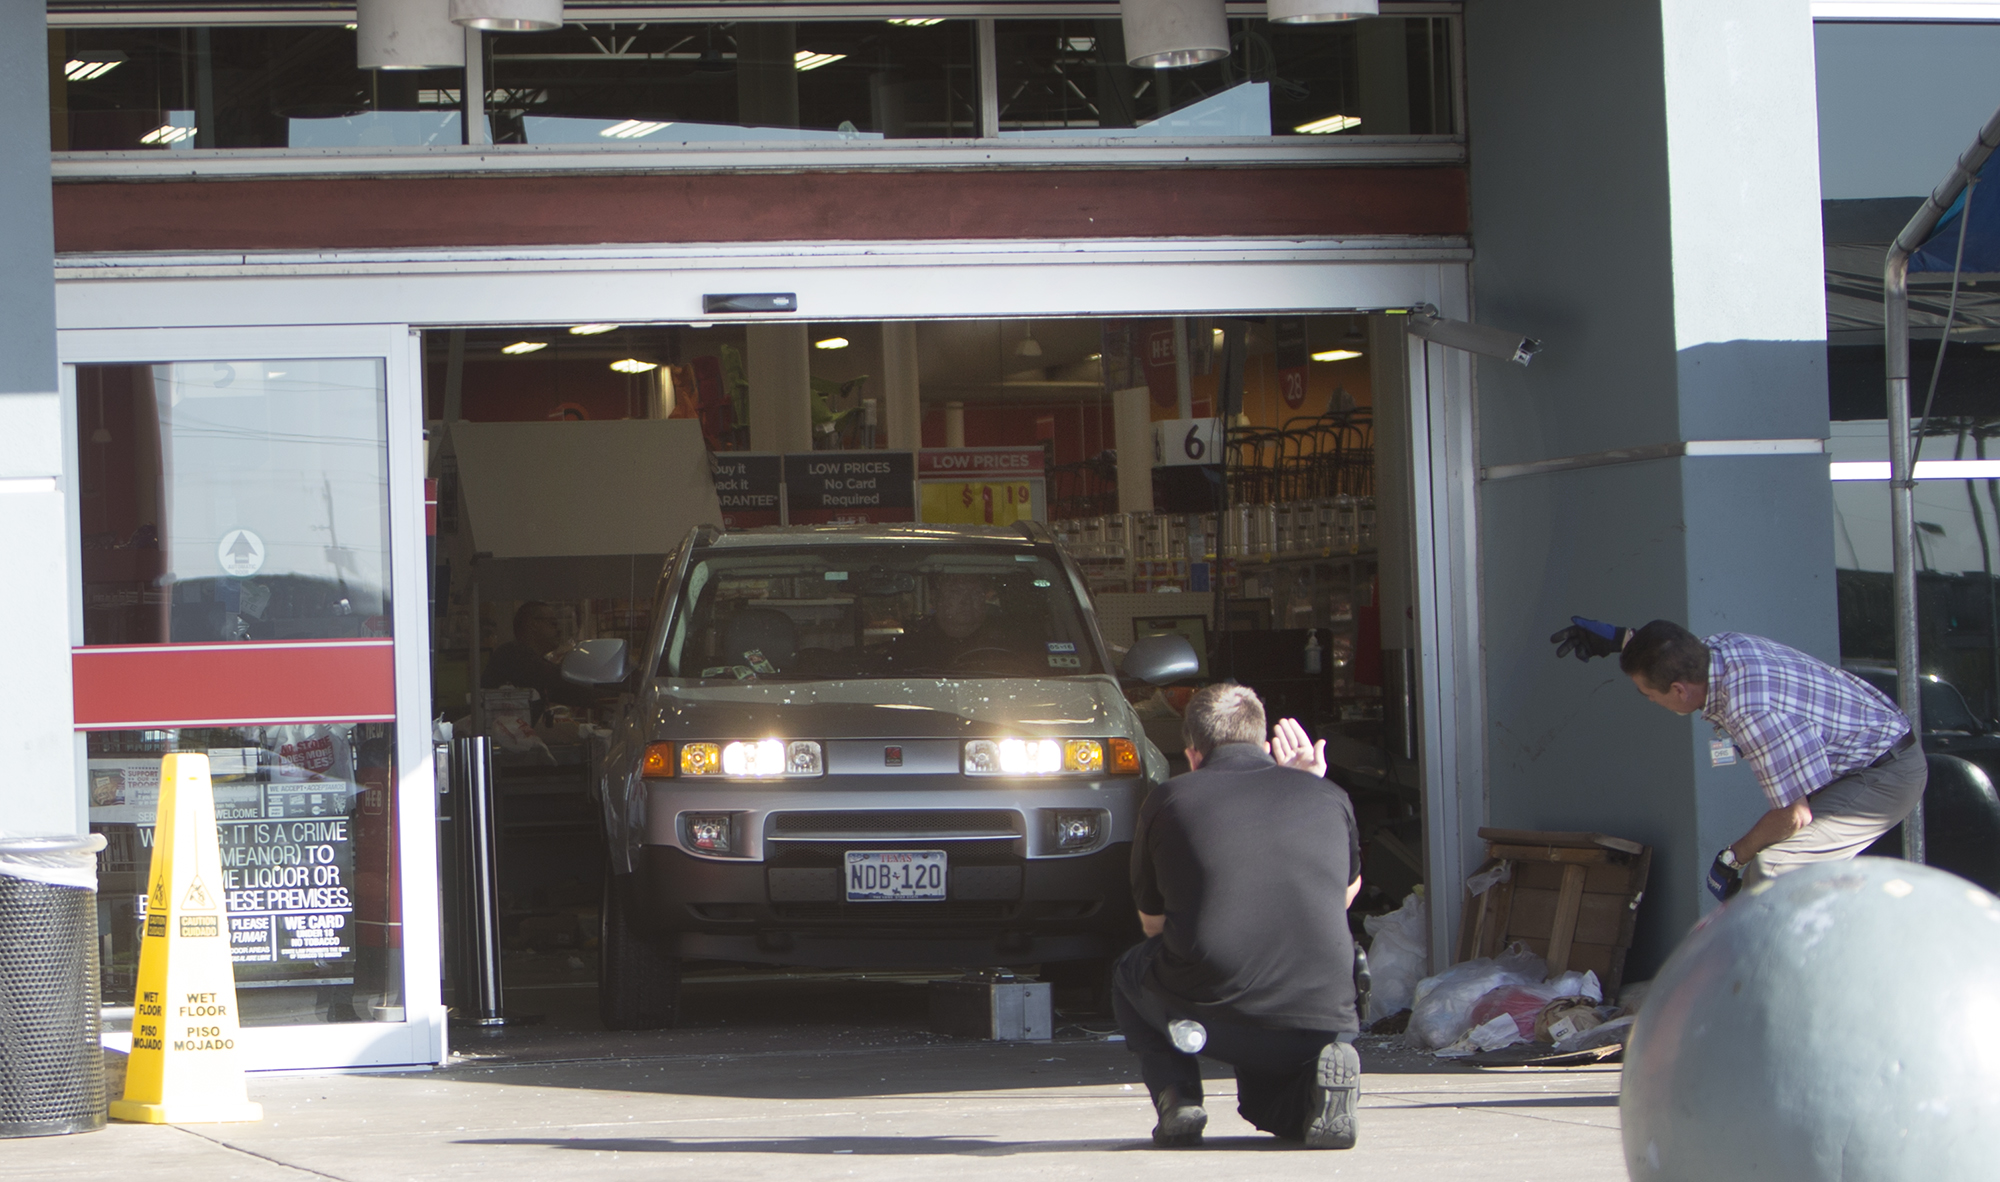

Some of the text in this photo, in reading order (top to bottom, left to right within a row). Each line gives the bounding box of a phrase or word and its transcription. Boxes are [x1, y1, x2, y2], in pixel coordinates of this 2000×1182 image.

[1287, 373, 1303, 401] 28
[1185, 424, 1205, 460] 6
[933, 455, 1029, 468] LOW PRICES
[809, 462, 891, 474] LOW PRICES
[716, 479, 739, 490] ack
[825, 478, 876, 489] No Card
[823, 493, 880, 507] Required
[281, 747, 334, 765] DOES MORE
[307, 757, 334, 770] LESS
[216, 808, 258, 819] WELCOME
[234, 825, 249, 845] IT
[255, 824, 270, 844] IS
[274, 824, 287, 843] A
[292, 821, 348, 842] CRIME
[220, 844, 335, 867] MEANOR) TO
[880, 854, 912, 863] TEXAS
[244, 866, 309, 889] LIQUOR
[314, 865, 340, 886] OR
[851, 864, 941, 889] NDB 120
[225, 887, 352, 911] HESE PREMISES.
[181, 916, 217, 926] CAUTION
[231, 918, 269, 930] PLEASE
[284, 914, 345, 930] WE CARD
[181, 926, 217, 937] CUIDADO
[231, 931, 268, 943] FUMAR
[304, 936, 340, 946] TOBACCO
[143, 991, 159, 1003] WET
[187, 993, 217, 1003] WET
[139, 1004, 162, 1016] FLOOR
[179, 1006, 226, 1016] FLOOR
[141, 1025, 157, 1037] PISO
[187, 1026, 220, 1037] PISO
[133, 1038, 162, 1050] MOJADO
[174, 1039, 234, 1051] MOJADO
